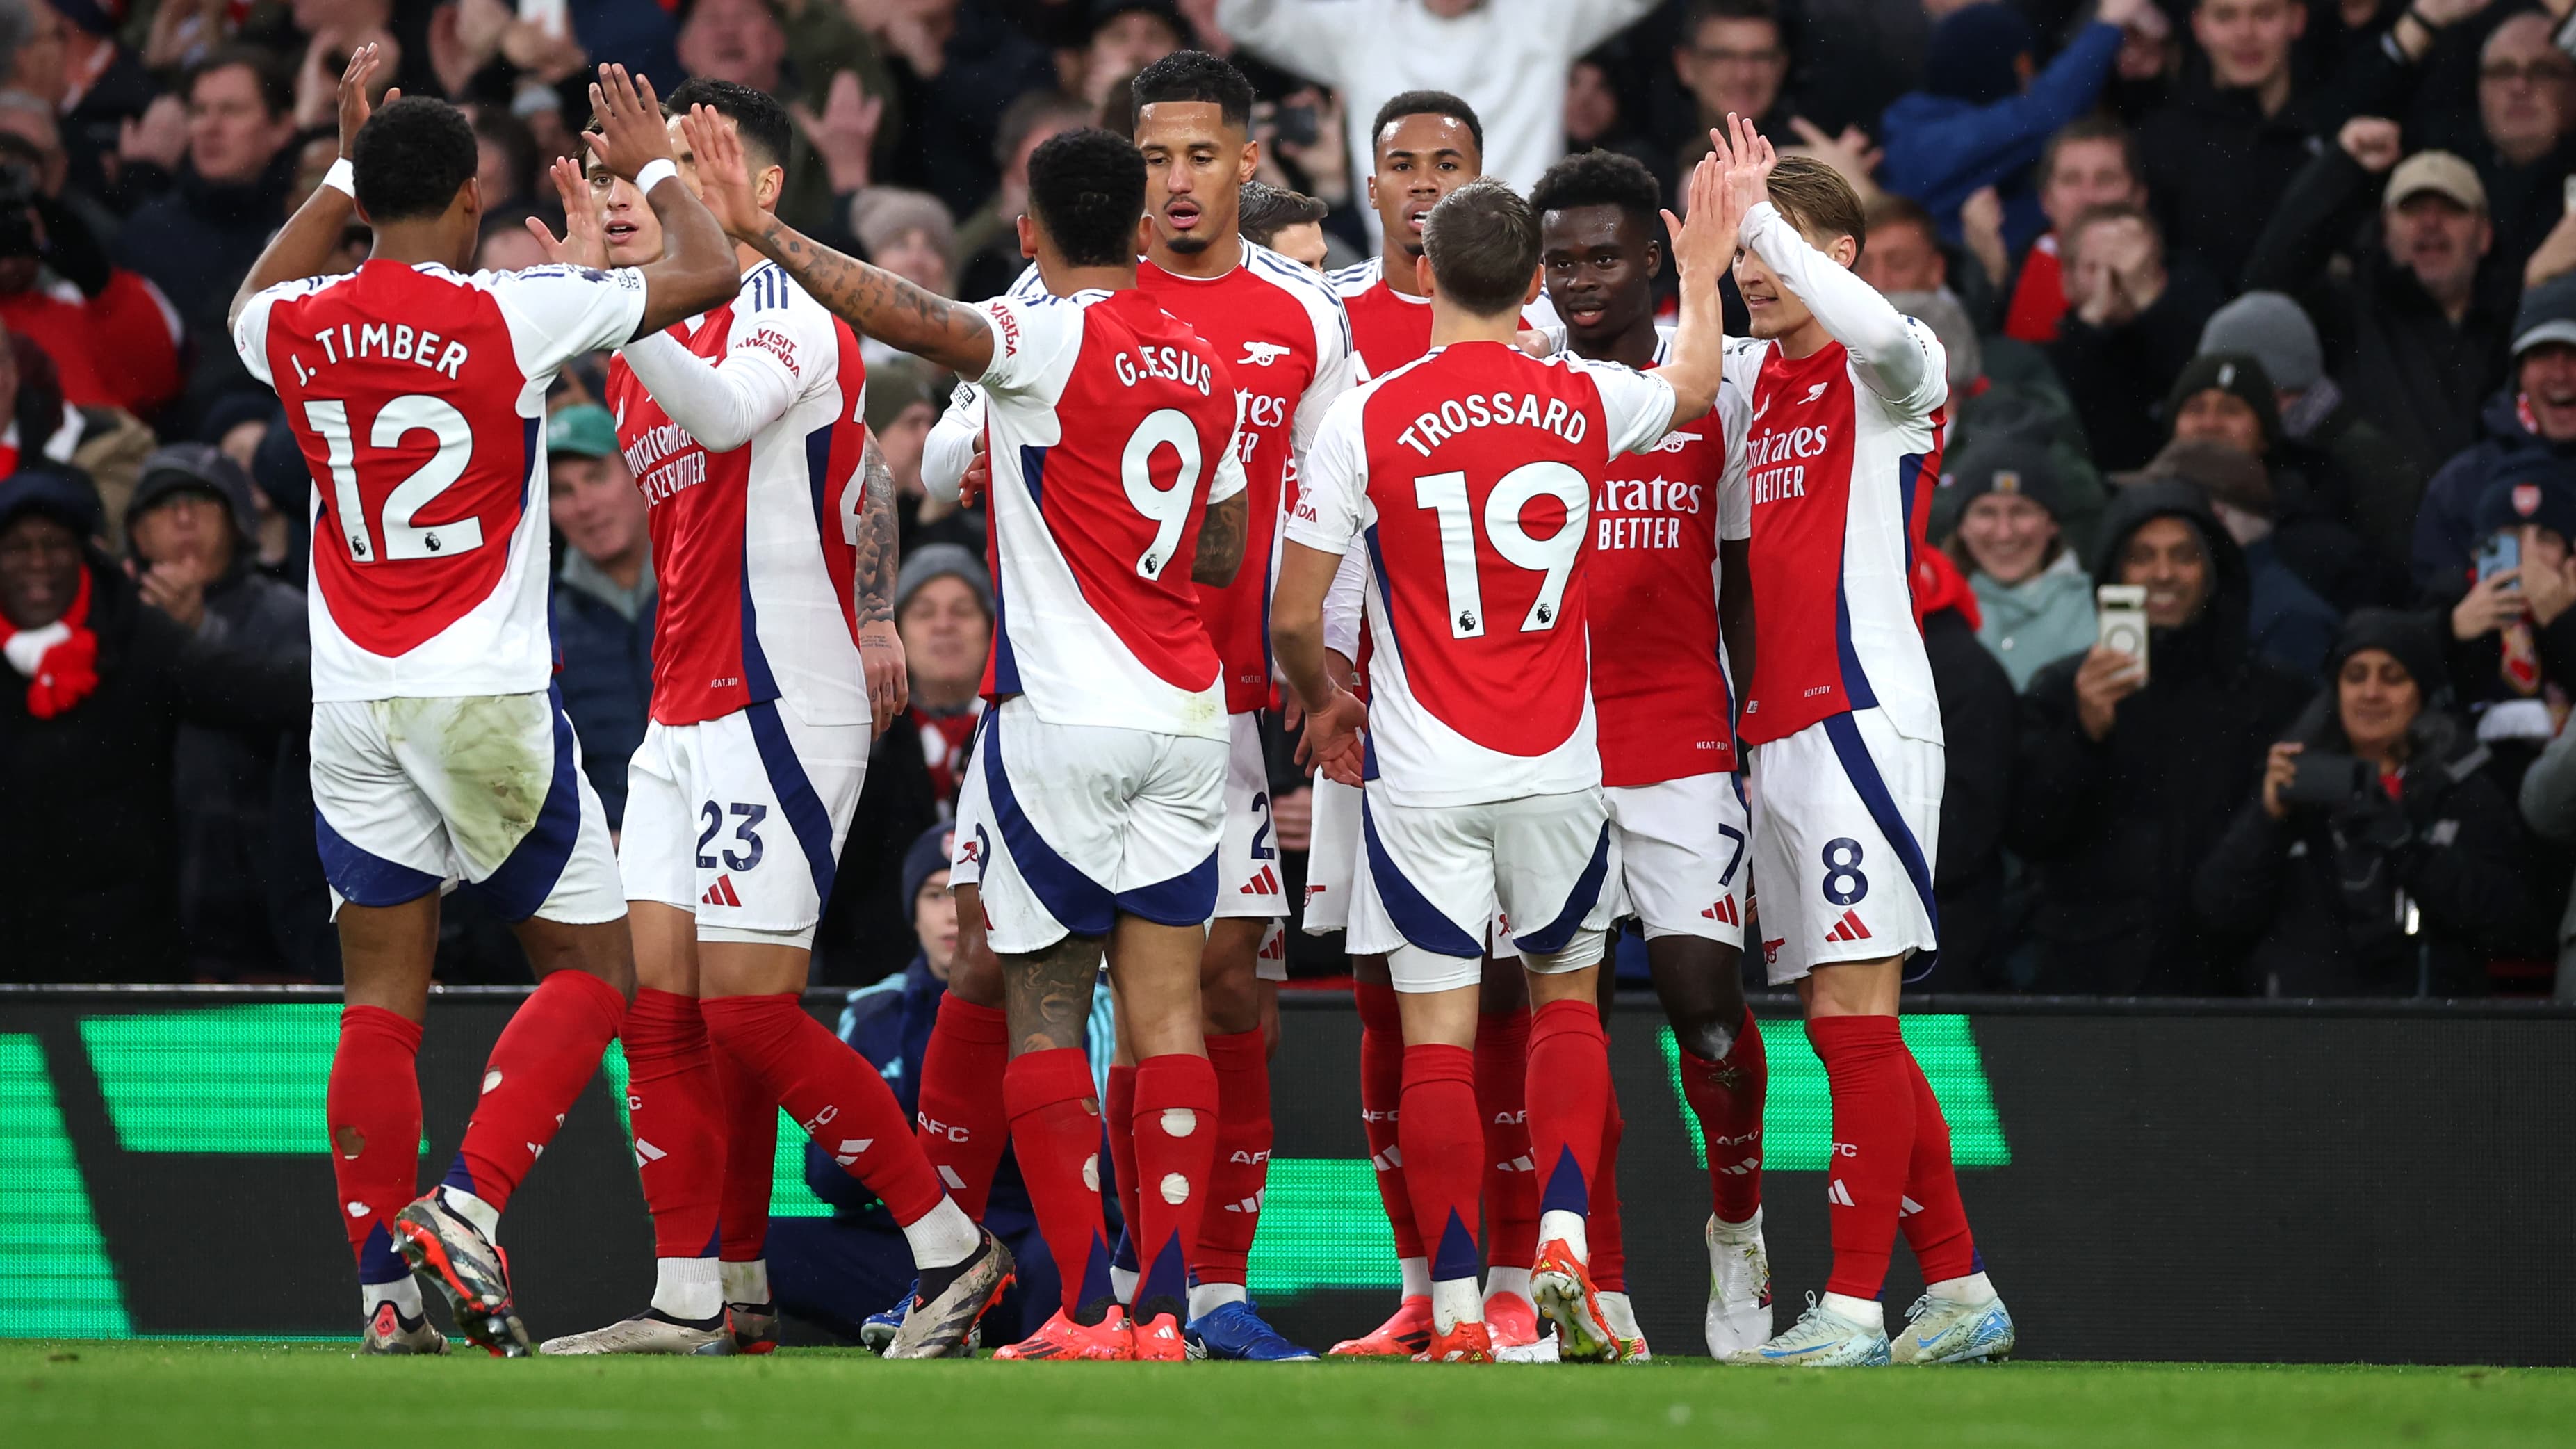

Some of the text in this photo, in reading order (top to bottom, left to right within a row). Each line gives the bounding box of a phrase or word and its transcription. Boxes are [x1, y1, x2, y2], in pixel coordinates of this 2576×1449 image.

[291, 322, 469, 387] J. TIMBER
[758, 328, 797, 354] VISIT
[1396, 391, 1588, 458] TROSSARD
[1747, 425, 1828, 471] mirates
[302, 394, 484, 564] 12
[1120, 407, 1203, 582] 9
[1595, 474, 1702, 515] rates
[1754, 465, 1806, 505] BETTER
[1413, 460, 1591, 640] 19
[1597, 517, 1681, 551] BETTER
[696, 799, 767, 872] 23
[1250, 791, 1275, 861] 2
[1718, 823, 1745, 887] 7
[1820, 836, 1869, 906] 8
[803, 1104, 839, 1135] FC
[918, 1110, 970, 1143] AFC
[1494, 1110, 1528, 1125] AF
[1716, 1128, 1759, 1146] AFC
[1832, 1142, 1858, 1158] FC
